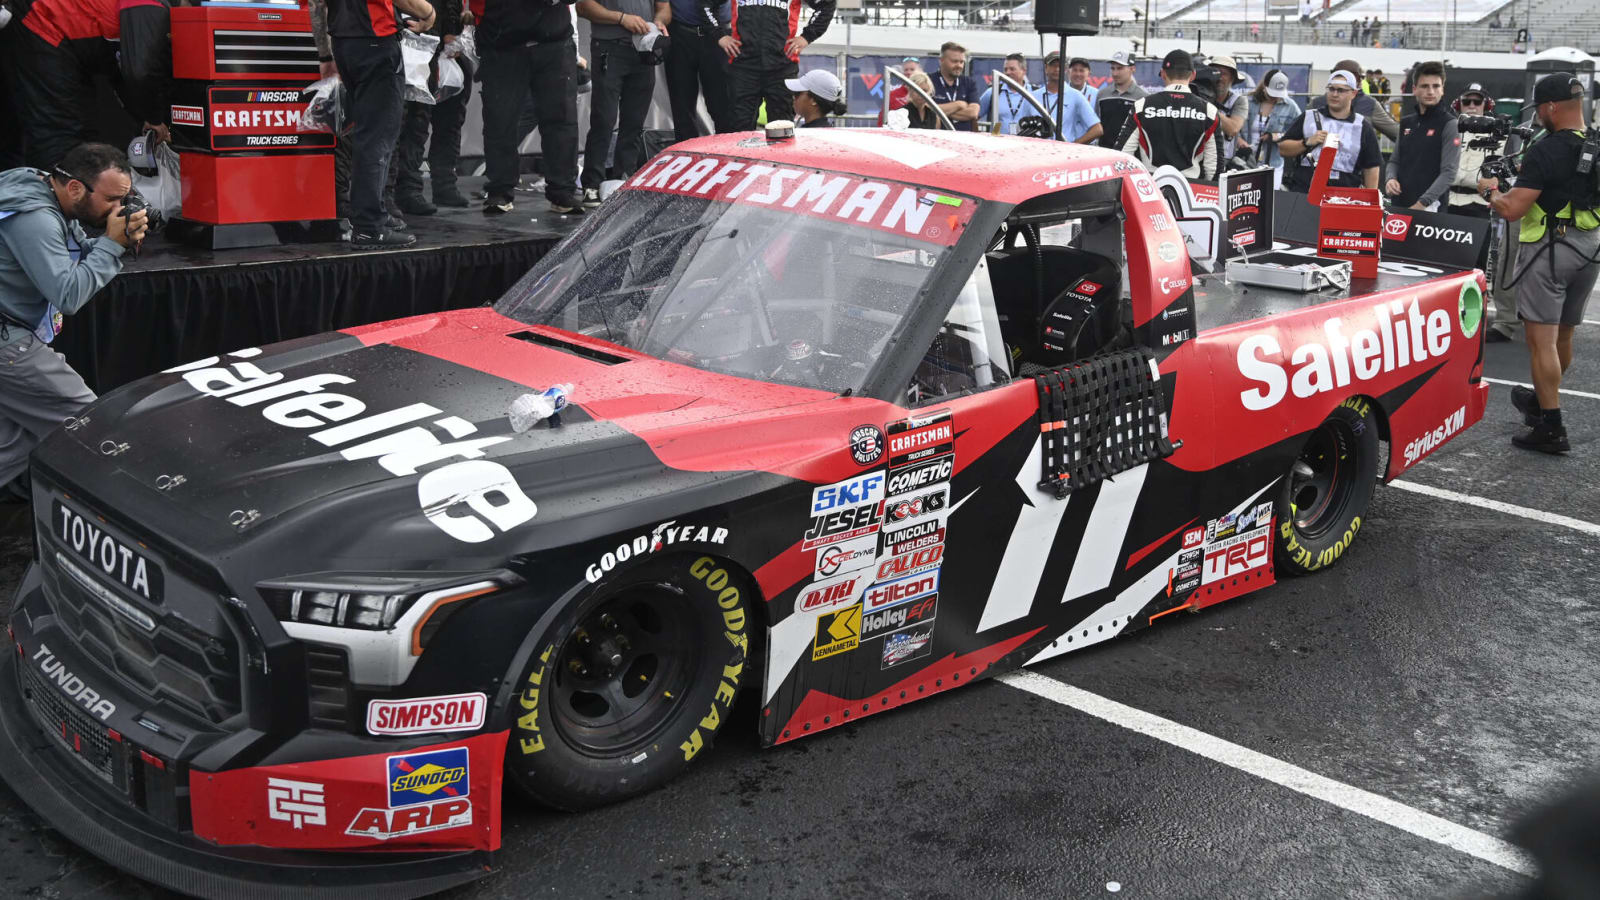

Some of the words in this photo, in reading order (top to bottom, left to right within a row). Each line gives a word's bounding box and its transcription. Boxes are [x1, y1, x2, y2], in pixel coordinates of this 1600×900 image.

[260, 91, 299, 102] NASCAR
[172, 108, 202, 122] CRAFTSMAN
[213, 110, 301, 128] CRAFTSM
[1144, 106, 1206, 120] Safelite
[247, 136, 270, 145] TRUCK
[271, 135, 299, 145] SERIES
[1045, 165, 1113, 189] HEIM
[630, 155, 939, 234] CRAFTSMAN
[1228, 193, 1243, 212] THE
[1243, 189, 1261, 206] TRIP
[1323, 238, 1375, 248] CRAFTSMAN
[1414, 224, 1474, 245] TOYOTA
[1065, 292, 1092, 302] TOYOTA
[1162, 330, 1182, 346] Mobil
[1237, 296, 1451, 411] Safelite
[1340, 396, 1370, 418] GLE
[852, 427, 879, 442] NASCAR
[891, 426, 951, 452] CRAFTSMAN
[1404, 406, 1465, 467] SiriusXM
[855, 448, 882, 462] SALUTES
[888, 461, 952, 492] COMETIC
[814, 475, 883, 512] SKF
[884, 489, 947, 526] KOOKS
[804, 503, 882, 540] JESEL
[888, 521, 936, 545] LINCOLN
[897, 534, 939, 553] WELDERS
[1184, 530, 1202, 546] SEM
[1239, 527, 1269, 542] DEVELOPMENT
[61, 505, 150, 599] TOYOTA
[585, 521, 729, 583] GOODYEAR
[877, 545, 944, 579] CALICO
[1205, 535, 1268, 576] TRD
[869, 577, 934, 606] tilton
[862, 609, 906, 633] Holley
[680, 557, 748, 761] GOODYEAR
[814, 639, 857, 658] KENNAMETAL
[33, 644, 116, 720] TUNDRA
[518, 644, 554, 754] EAGLE
[376, 700, 476, 728] SIMPSON
[395, 768, 464, 790] SUNOCO
[349, 799, 470, 833] ARP
